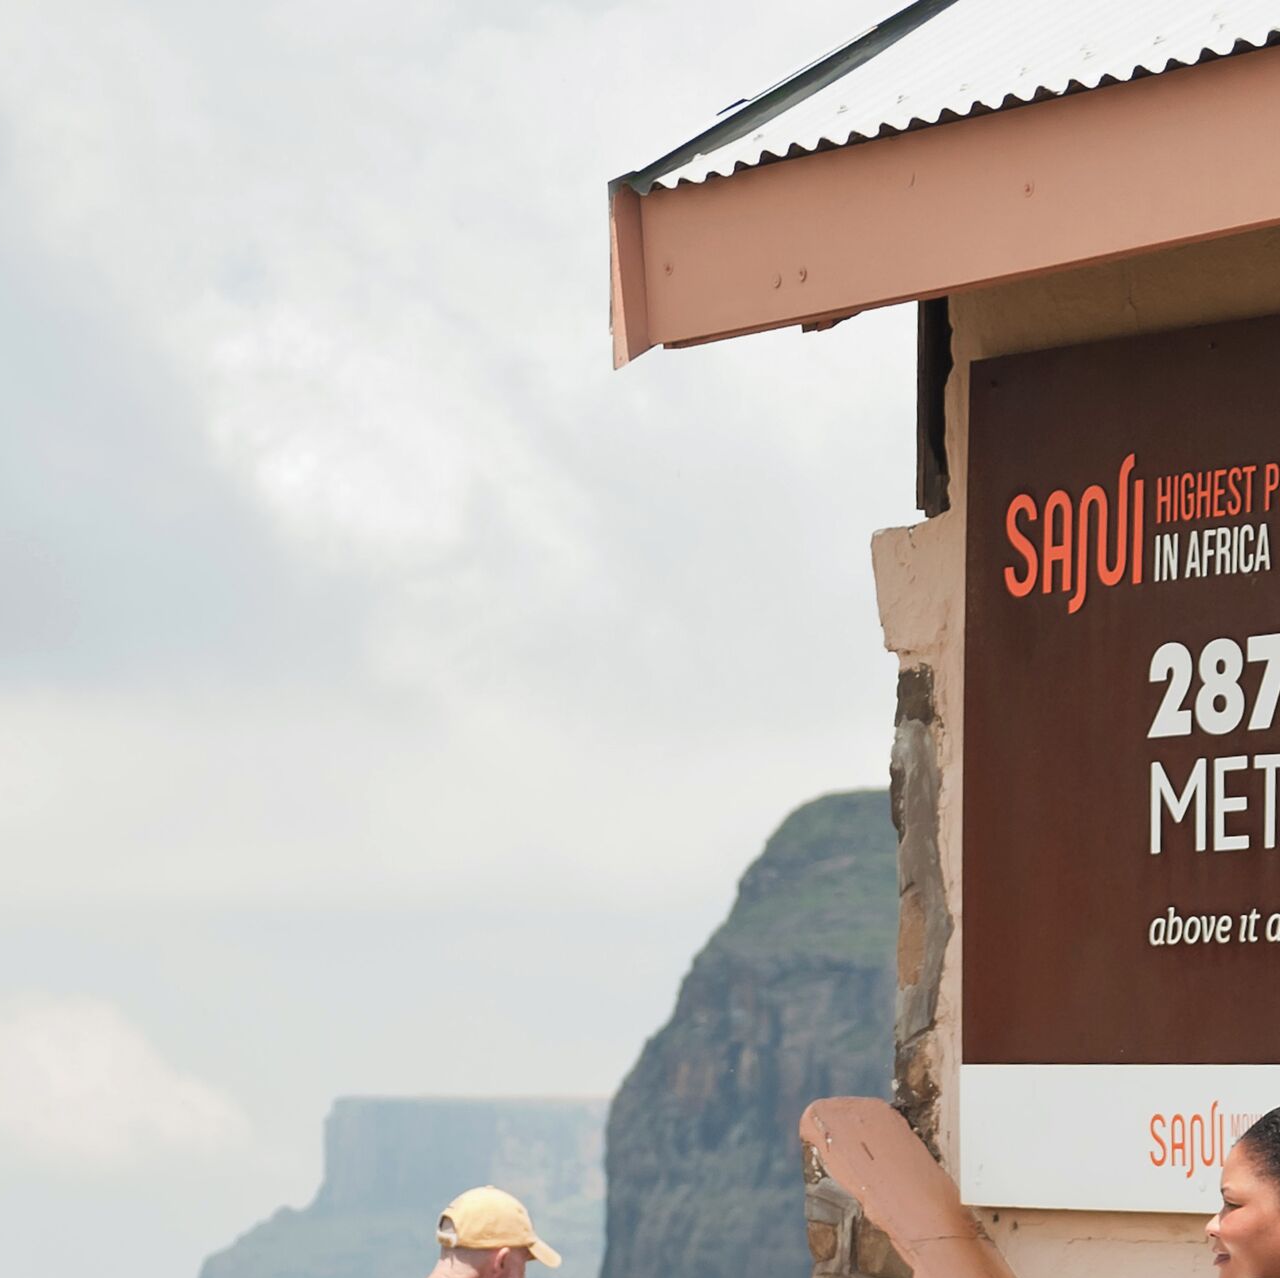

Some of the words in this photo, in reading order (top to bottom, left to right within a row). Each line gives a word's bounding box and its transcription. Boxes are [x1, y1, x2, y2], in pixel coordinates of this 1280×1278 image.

[1156, 465, 1257, 524] HIGHEST
[1004, 452, 1145, 615] SANI
[1154, 532, 1179, 582] IN
[1185, 523, 1271, 578] AFRICA
[1148, 906, 1233, 946] above
[1238, 908, 1261, 943] it
[1149, 1099, 1225, 1179] SANI
